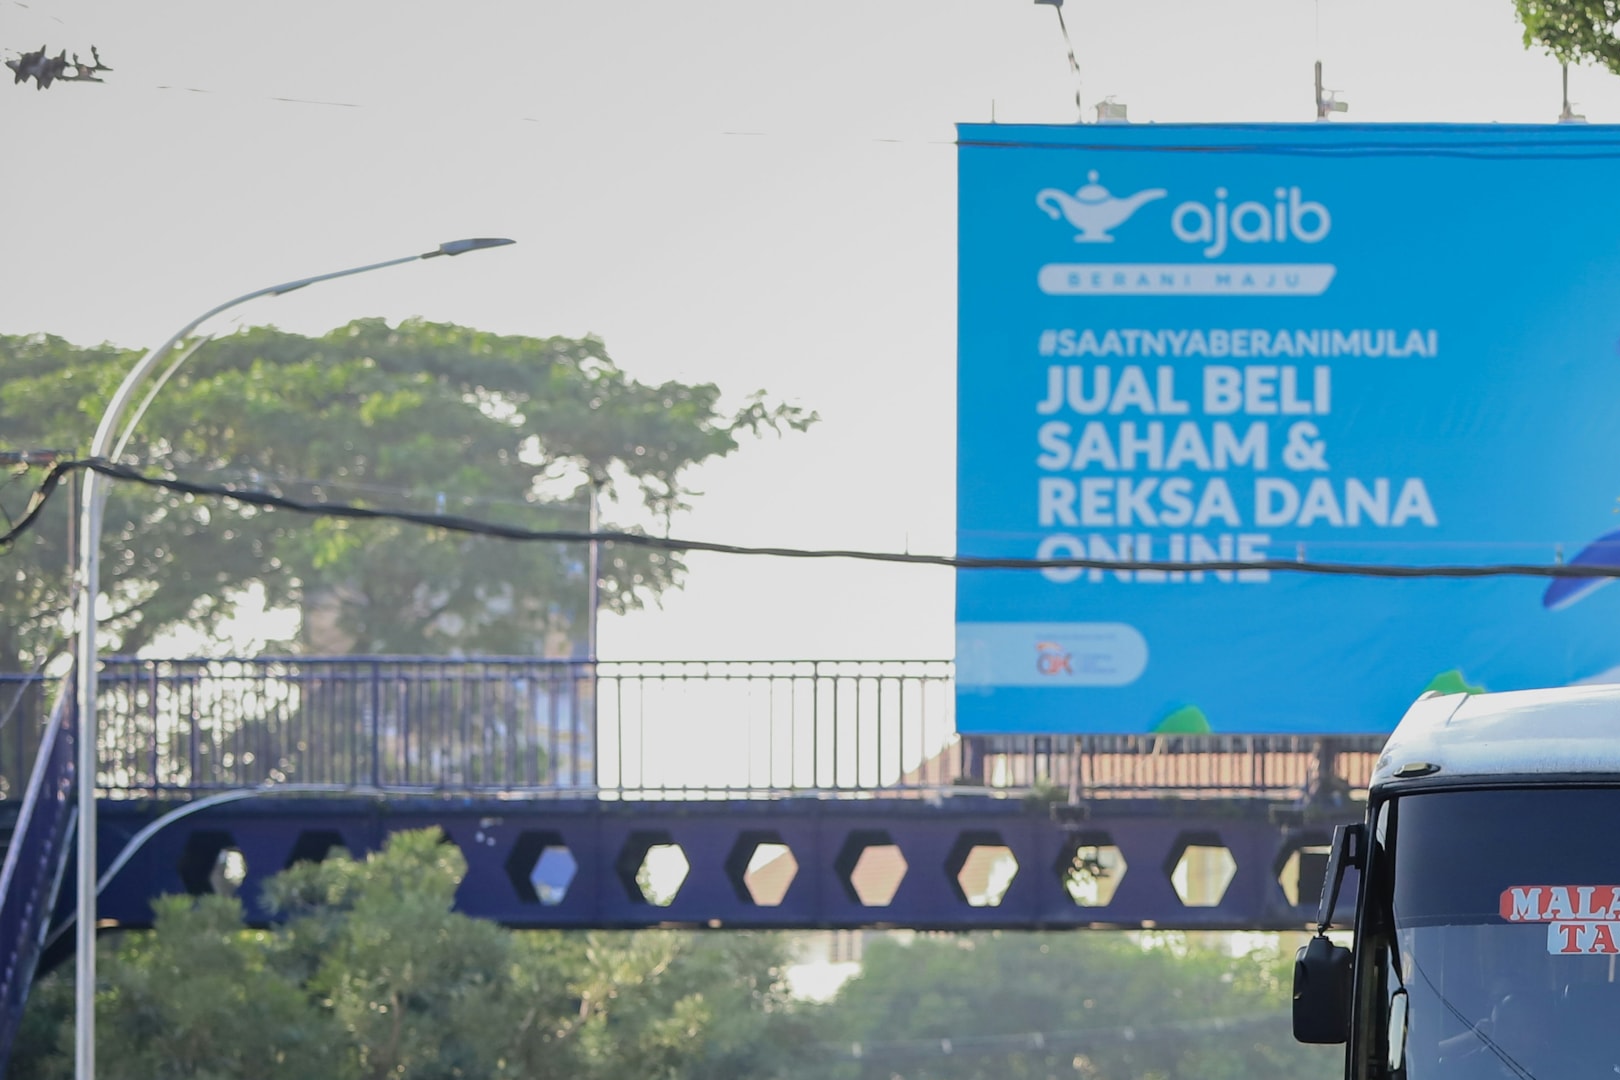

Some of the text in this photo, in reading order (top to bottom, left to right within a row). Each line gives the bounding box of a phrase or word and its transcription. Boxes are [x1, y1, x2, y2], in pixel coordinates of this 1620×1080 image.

[1171, 186, 1331, 258] ajaib
[1067, 272, 1300, 287] BERANI MAJU
[1038, 329, 1438, 357] #SAATNYABERANIMULAI
[1037, 365, 1331, 415] JUAL BELI
[1037, 421, 1329, 471] SAHAM &
[1038, 477, 1438, 526] REKSA DANA
[1036, 533, 1271, 583] ONLINE
